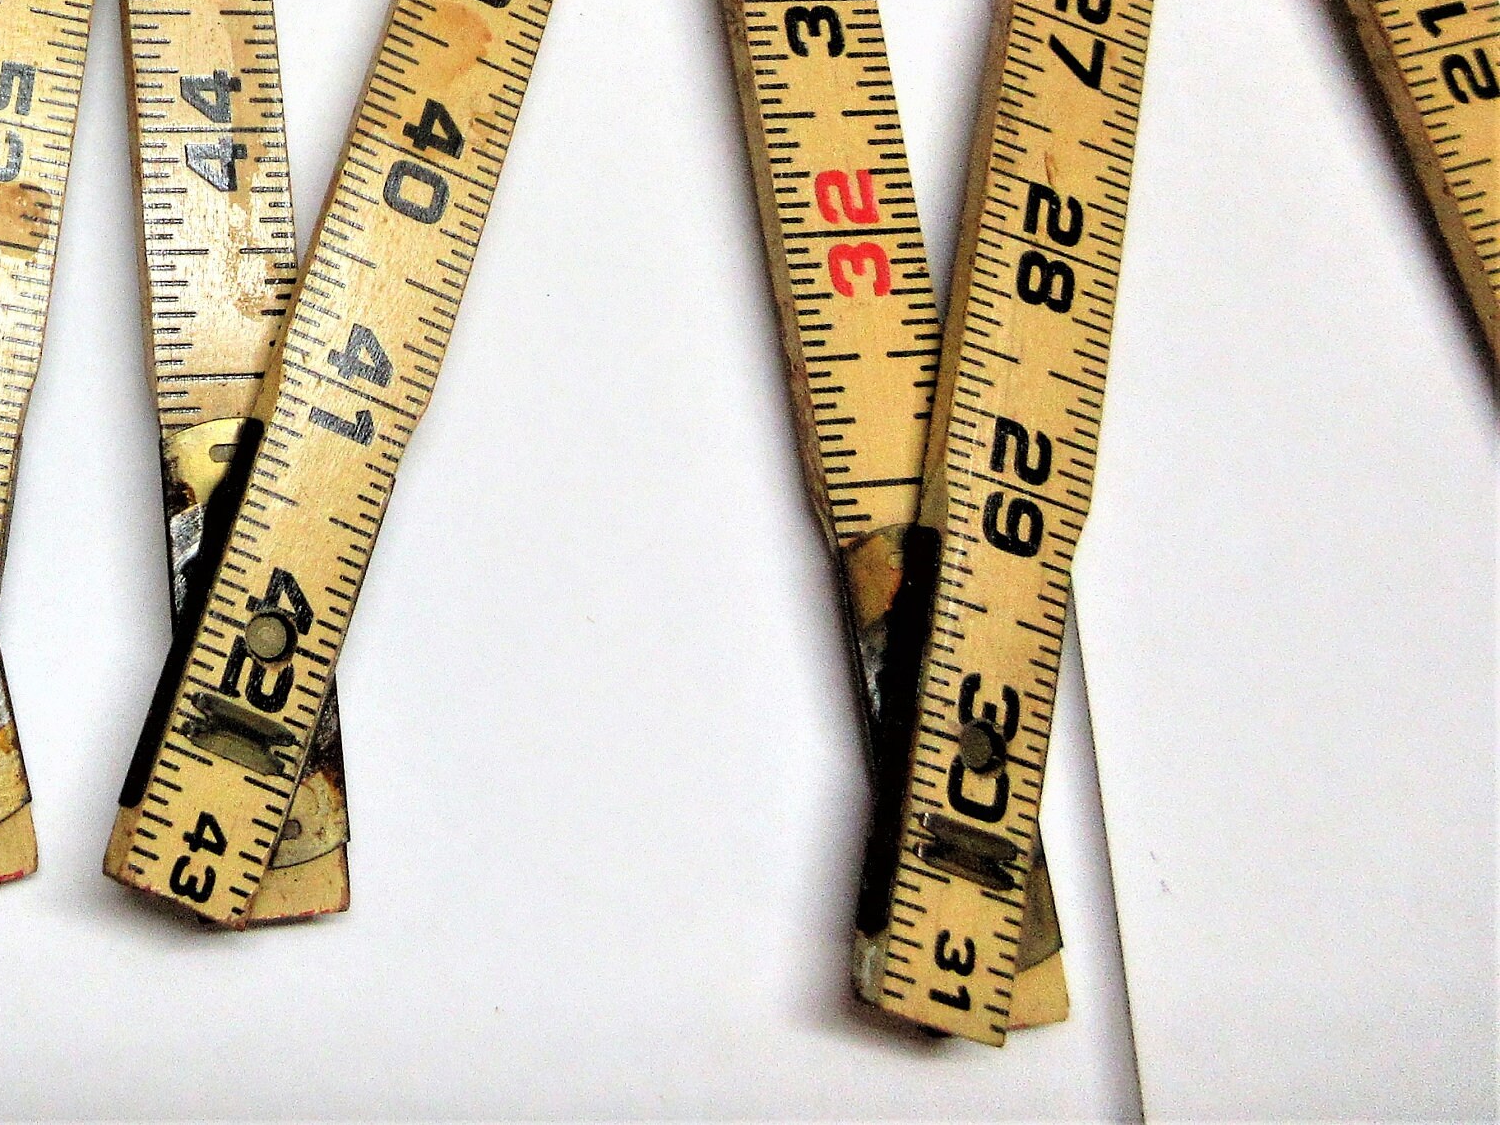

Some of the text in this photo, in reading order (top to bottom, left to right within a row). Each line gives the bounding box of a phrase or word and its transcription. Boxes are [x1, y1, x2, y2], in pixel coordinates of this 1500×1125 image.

[1417, 1, 1500, 105] 21
[179, 68, 248, 193] 44
[381, 98, 465, 225] 40
[813, 168, 893, 298] 32
[1015, 182, 1085, 315] 28
[308, 322, 395, 447] 41
[981, 416, 1053, 559] 29
[218, 567, 316, 715] 42
[946, 671, 1021, 826] 30
[168, 809, 228, 905] 43
[928, 928, 976, 1015] 31
